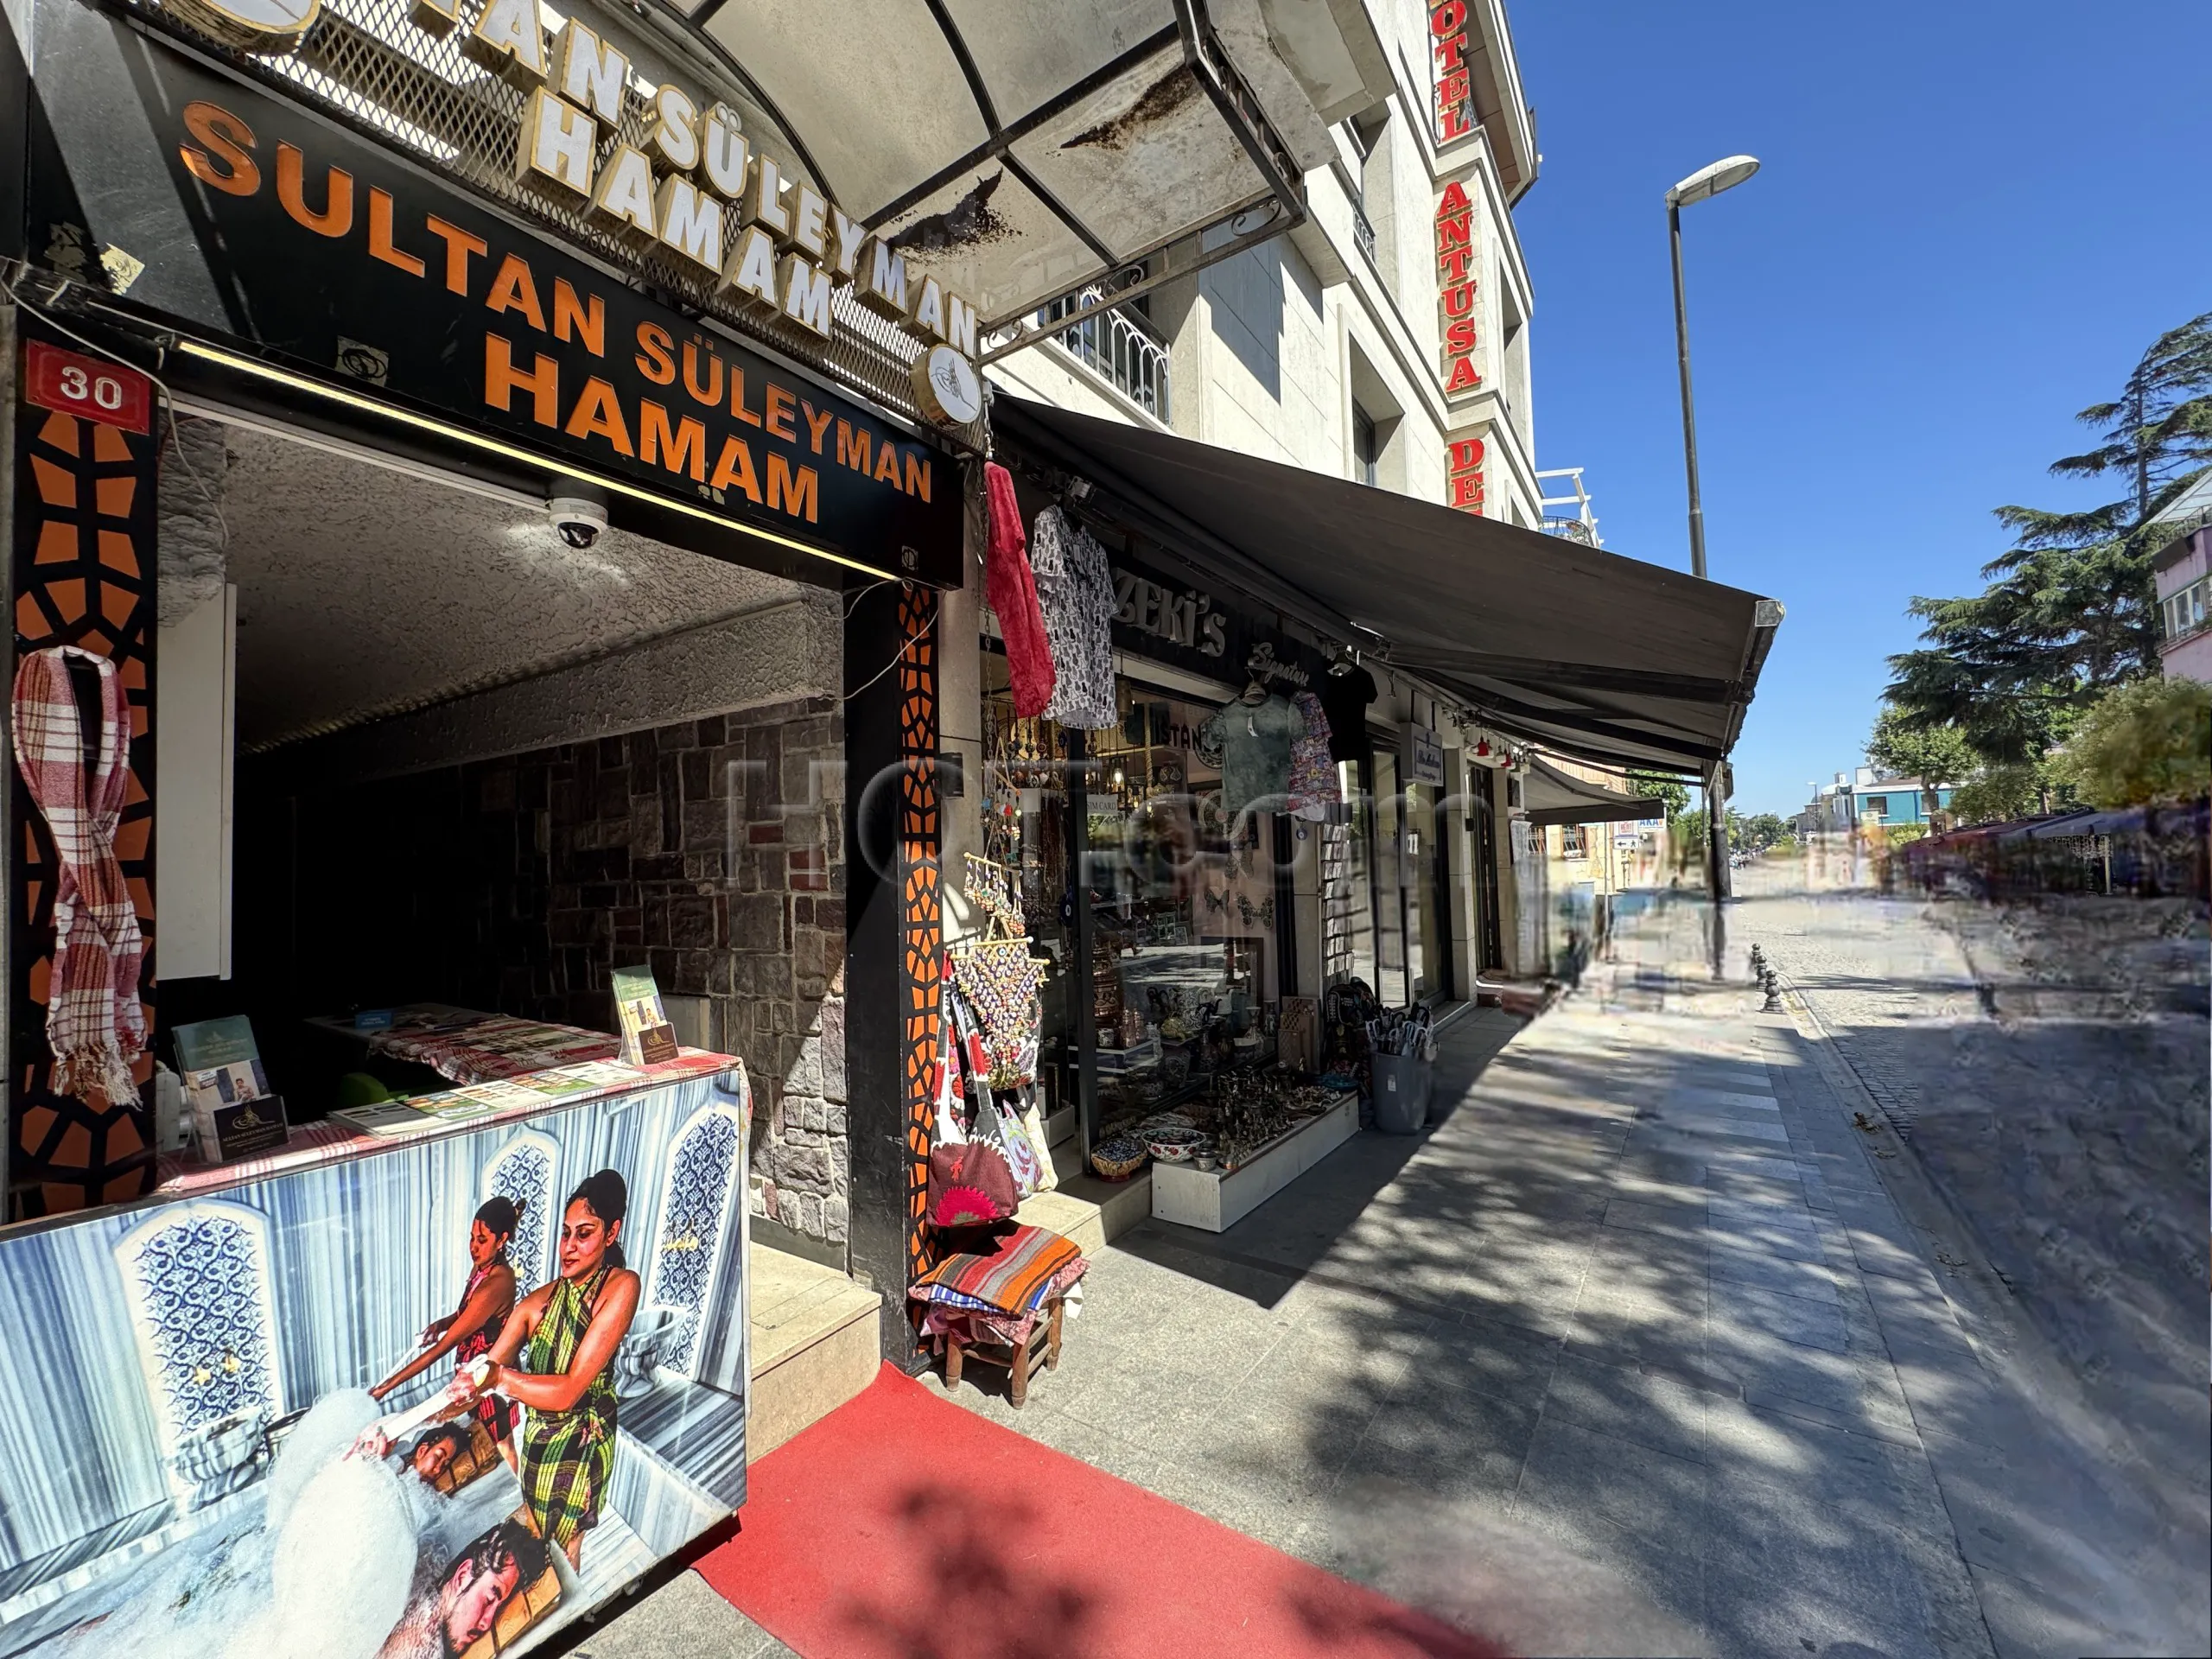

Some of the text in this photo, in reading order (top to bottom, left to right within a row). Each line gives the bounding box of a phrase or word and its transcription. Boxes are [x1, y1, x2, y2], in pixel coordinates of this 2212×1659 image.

[180, 99, 931, 504] SULTAN SÜLEYMAN
[530, 85, 832, 340] HAMAM
[654, 84, 978, 359] SÜLEYMAN
[1429, 0, 1485, 517] OTEL ANTUSA DE
[60, 365, 123, 410] 30
[485, 331, 818, 524] HAMAM
[1247, 641, 1310, 688] Signature
[1099, 801, 1116, 810] CARD
